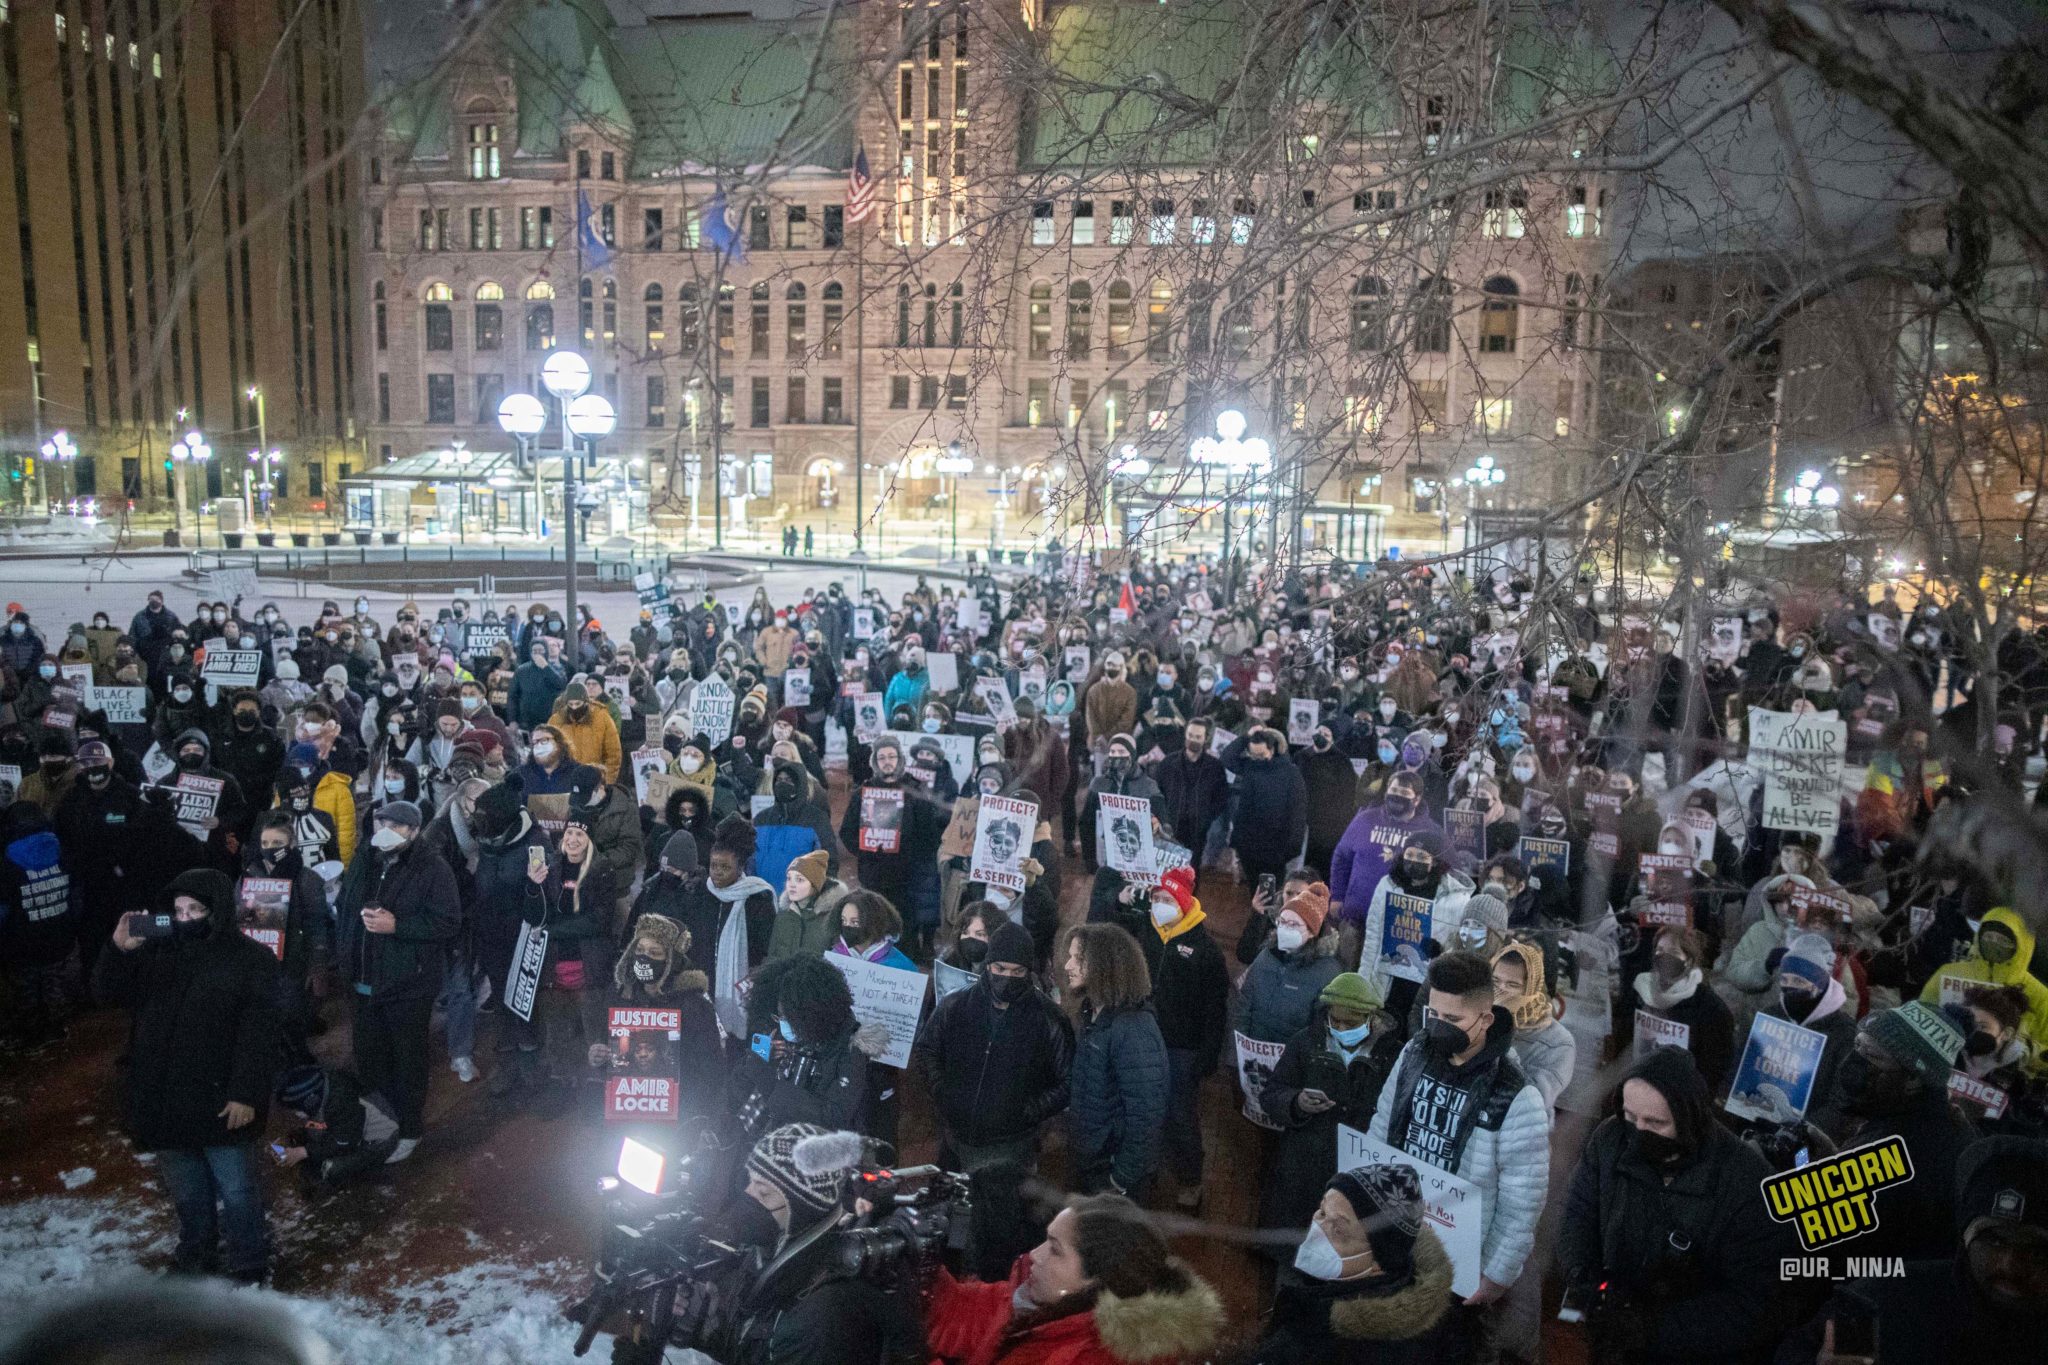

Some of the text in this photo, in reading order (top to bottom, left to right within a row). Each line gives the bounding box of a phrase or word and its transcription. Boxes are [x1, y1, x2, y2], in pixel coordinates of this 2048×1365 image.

[471, 626, 506, 635] BLACK
[209, 653, 233, 662] FREY
[469, 648, 492, 657] MAT
[205, 661, 257, 672] AMIR DIED
[93, 688, 134, 699] BLACK
[697, 682, 730, 699] KNOW
[99, 700, 132, 710] LIVES
[692, 699, 733, 715] JUSTICE
[107, 710, 136, 720] TTER
[693, 713, 729, 727] KNOW
[692, 727, 729, 745] PACE
[1776, 727, 1836, 753] AMIR
[1771, 753, 1837, 774] LOCKE
[180, 776, 221, 791] JUSTICE
[863, 789, 903, 800] JUSTICE
[1790, 792, 1811, 806] BE
[982, 796, 1035, 816] PROTECT?
[1101, 795, 1147, 813] PROTECT?
[177, 805, 209, 819] DIED
[1768, 807, 1832, 828] ALIVE
[1525, 841, 1564, 855] JUSTICE
[1641, 855, 1692, 867] JUSTICE
[973, 868, 1023, 888] & SERVE?
[1120, 869, 1158, 883] SERVE?
[243, 880, 289, 892] JUSTICE
[1388, 893, 1431, 915] JUSTICE
[1792, 886, 1851, 913] JUSTICE
[28, 910, 39, 921] THE
[1395, 914, 1422, 929] AMIR
[243, 929, 279, 943] AMIR
[862, 988, 880, 999] NOT
[891, 991, 920, 1006] THREAT
[611, 1011, 677, 1027] JUSTICE
[1635, 1012, 1684, 1037] PROTECT?
[611, 1028, 631, 1037] FOR
[1758, 1020, 1818, 1051] JUSTICE
[616, 1077, 670, 1096] AMIR
[1948, 1074, 2005, 1106] USTICE
[615, 1097, 669, 1112] LOCKE
[1347, 1133, 1380, 1161] The
[1417, 1128, 1445, 1155] NOT
